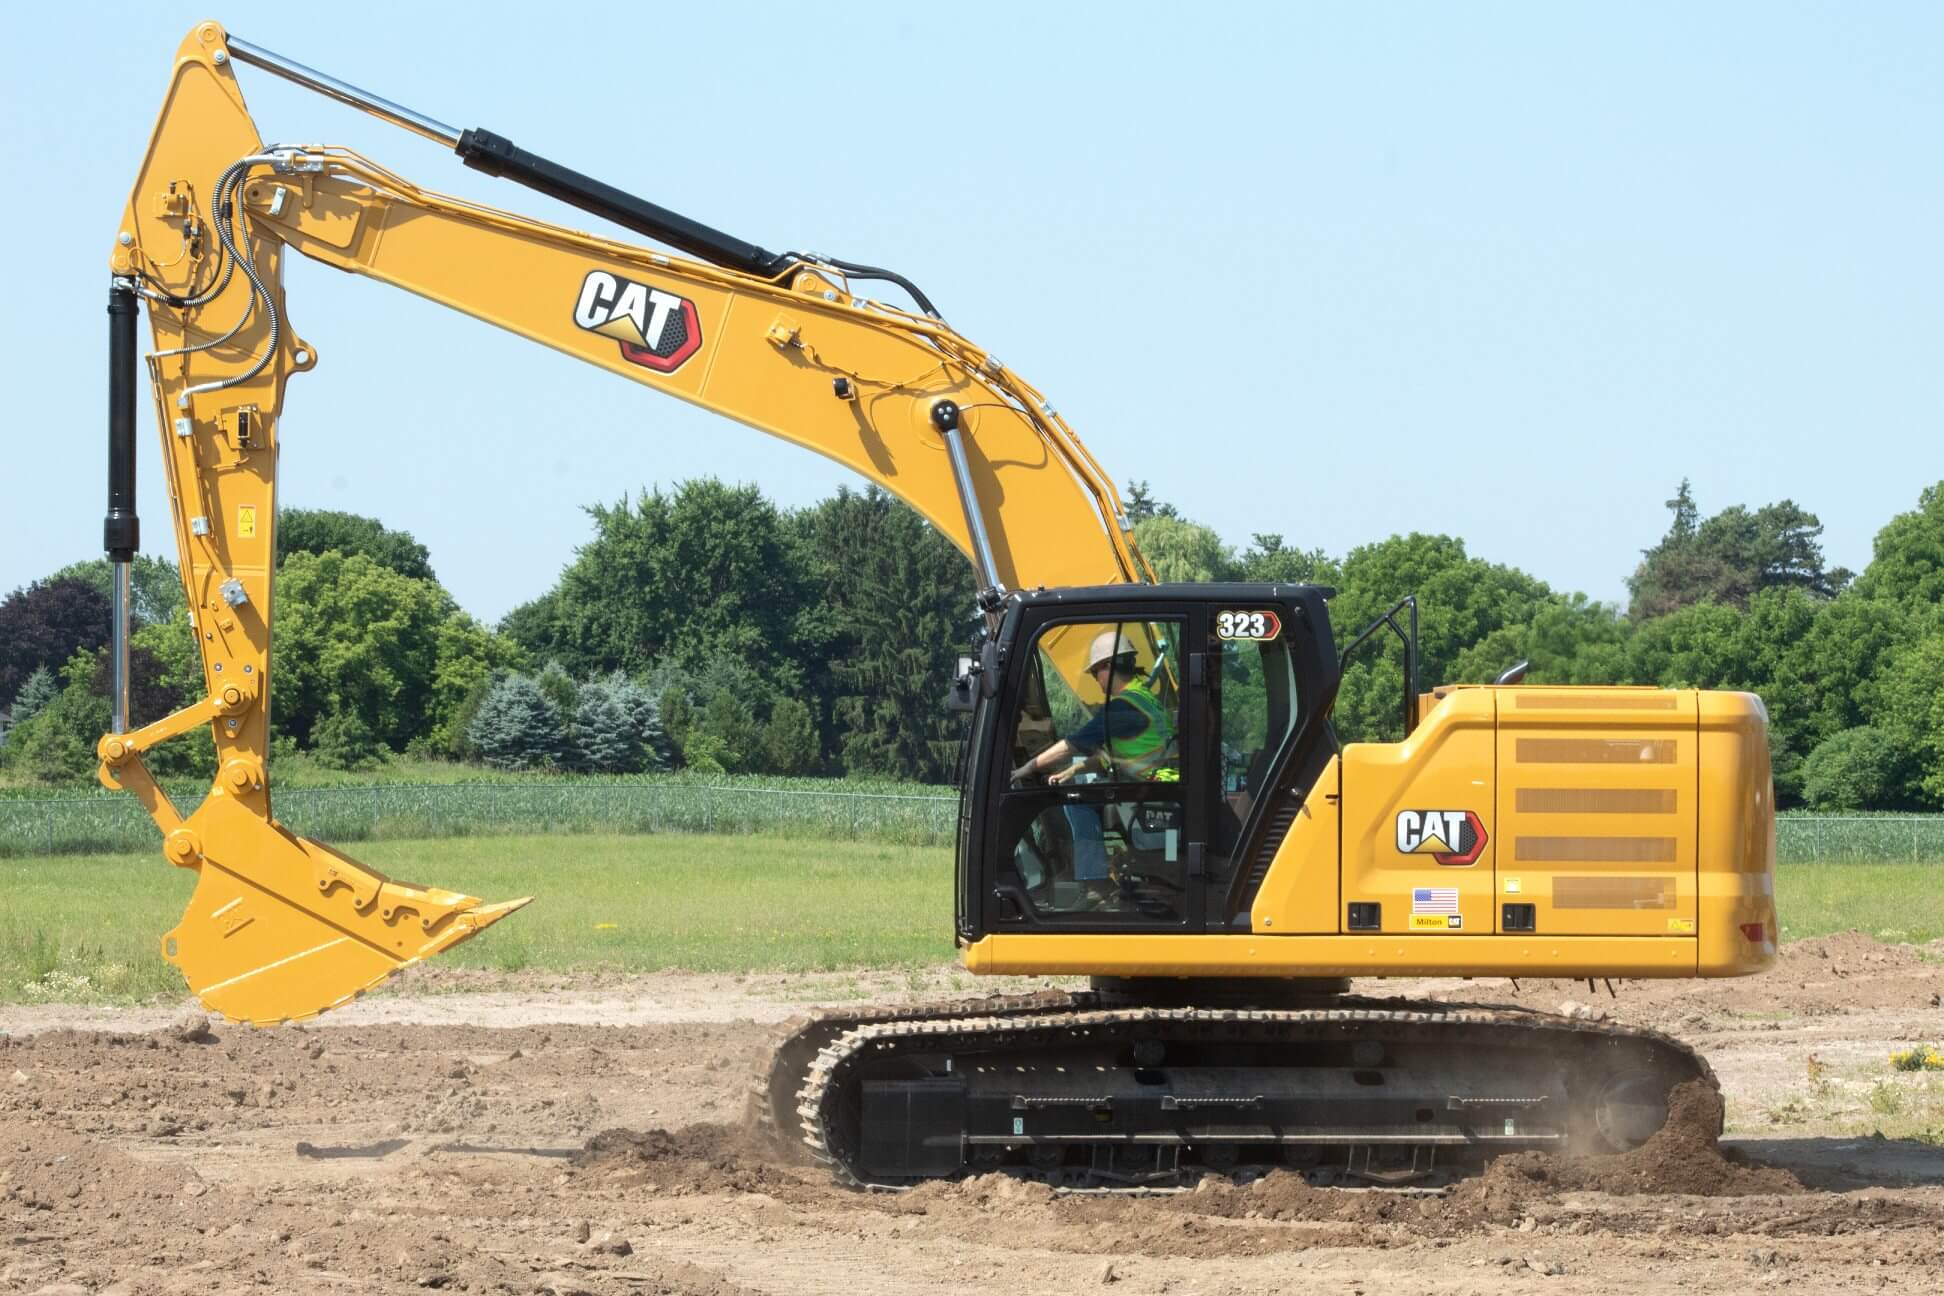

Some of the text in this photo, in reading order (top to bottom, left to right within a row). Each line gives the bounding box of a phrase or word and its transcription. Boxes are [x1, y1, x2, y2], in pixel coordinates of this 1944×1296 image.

[575, 271, 682, 350] CAT
[1219, 613, 1265, 637] 323
[1397, 810, 1466, 853] CAT
[1416, 918, 1442, 926] Milton
